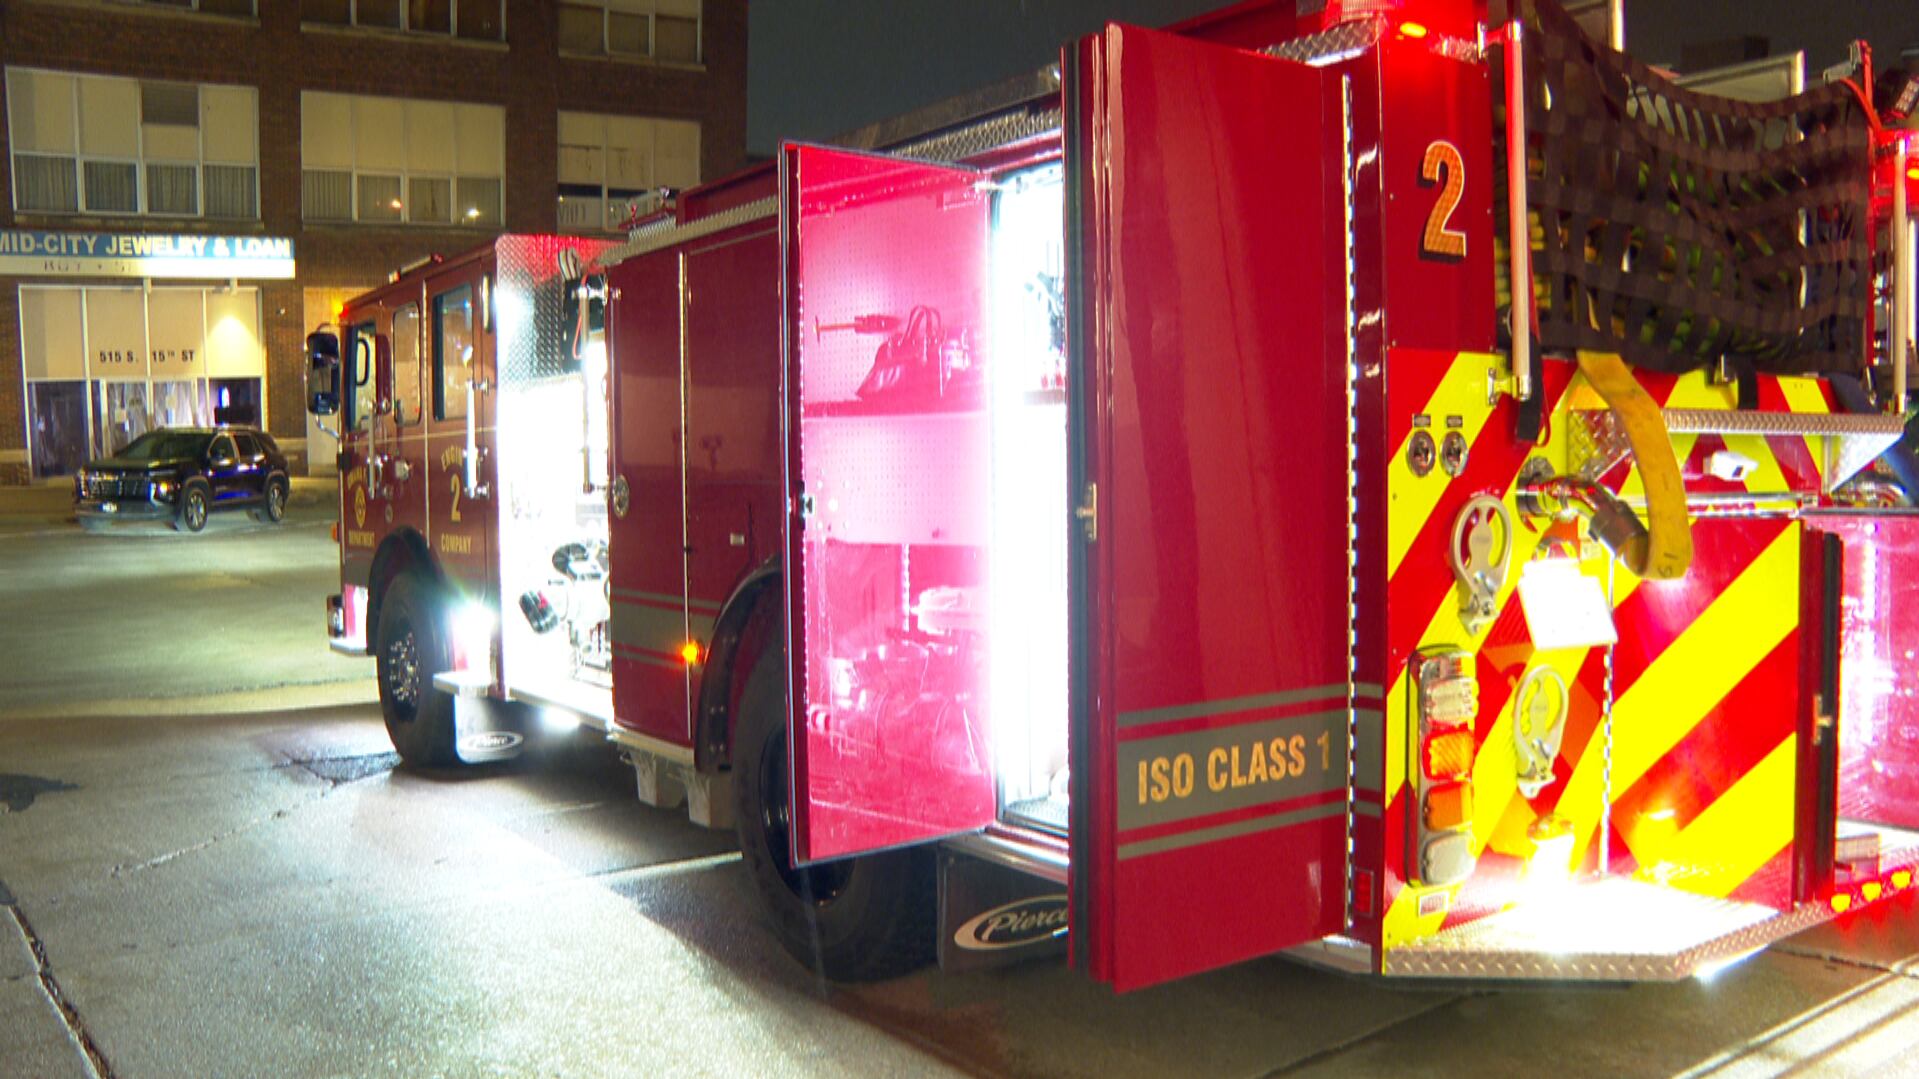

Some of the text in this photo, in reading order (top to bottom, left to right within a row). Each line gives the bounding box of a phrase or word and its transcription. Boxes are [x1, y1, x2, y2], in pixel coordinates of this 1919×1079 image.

[1420, 140, 1467, 261] 2
[0, 232, 291, 258] MID-CITY JEWELRY & LOAN
[99, 350, 122, 363] 515
[181, 349, 195, 362] ST
[450, 473, 462, 522] 2
[441, 533, 472, 555] COMPANY
[1138, 730, 1330, 805] ISO CLASS 1
